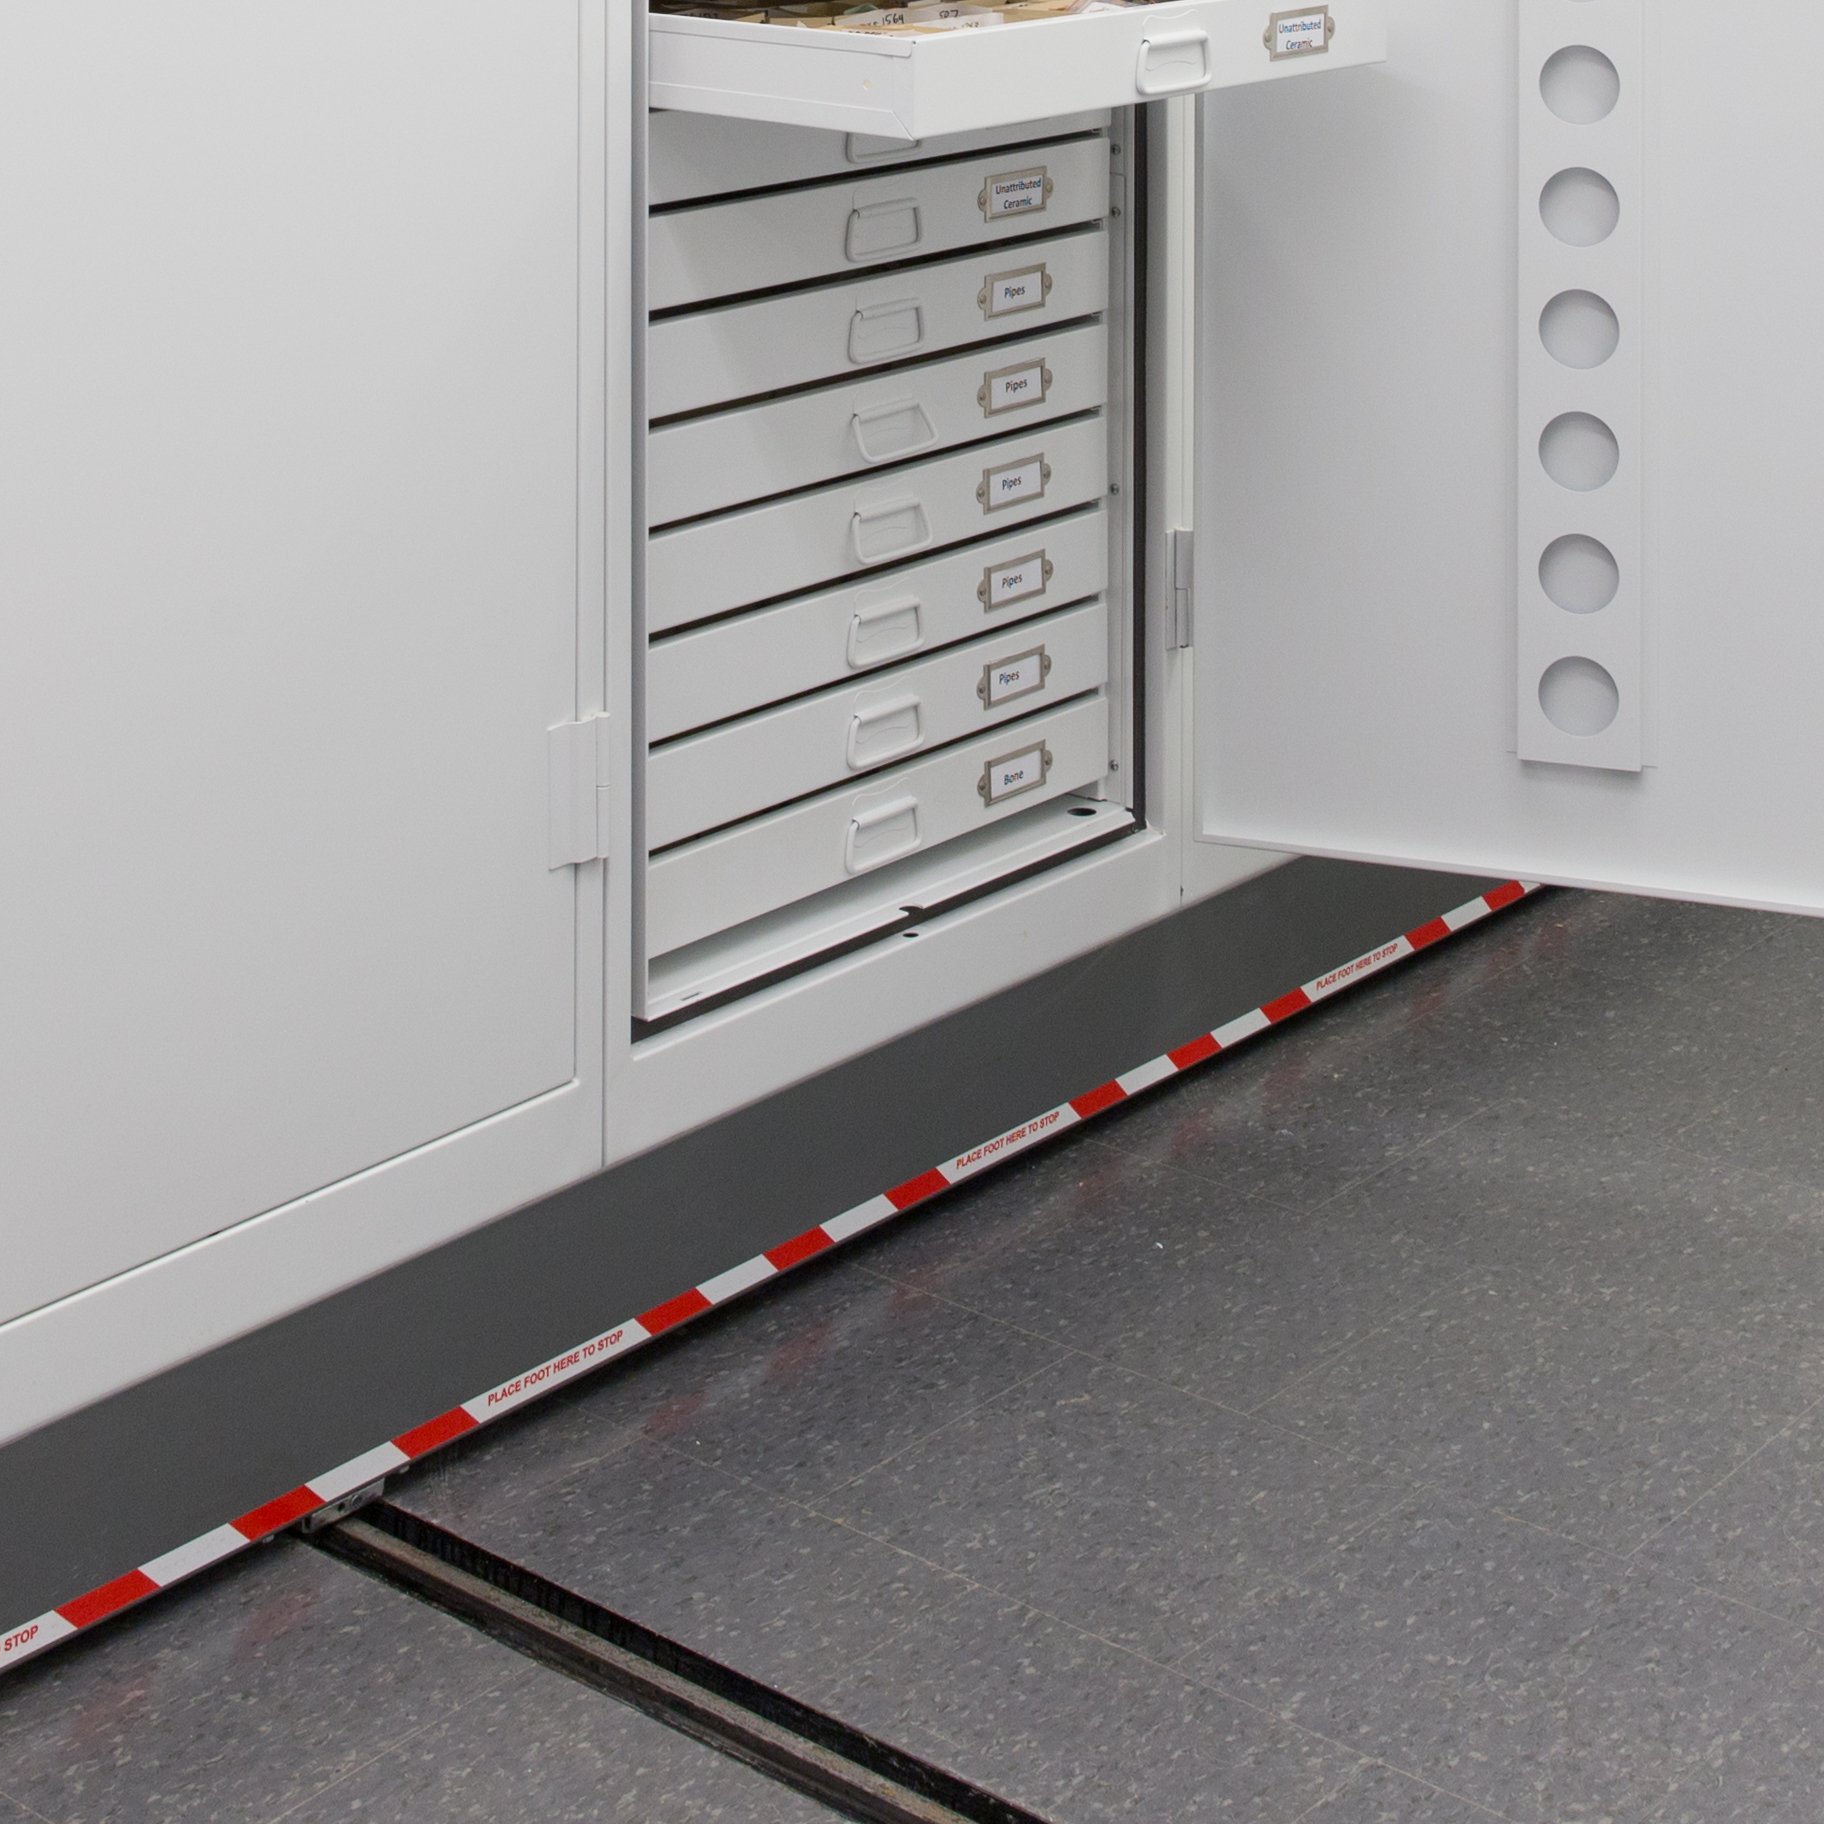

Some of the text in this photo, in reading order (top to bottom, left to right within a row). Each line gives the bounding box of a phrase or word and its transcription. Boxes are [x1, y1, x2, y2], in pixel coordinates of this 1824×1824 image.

[1279, 18, 1322, 34] Unattributed
[1286, 38, 1313, 50] Ceramic
[995, 177, 1042, 195] Unattributed
[1003, 196, 1032, 209] Ceramic
[1004, 285, 1026, 299] Pipes
[1005, 378, 1028, 393] Pipes
[1002, 476, 1022, 491] Pipes
[1002, 573, 1023, 589] Pipes
[999, 670, 1020, 685] Pipes
[1004, 770, 1024, 785] Bone
[1315, 943, 1398, 991] PLACE FOOT HERE TO STOP
[955, 1111, 1060, 1169] PLACE FOOT HERE TO STOP
[487, 1329, 624, 1407] PLACE FOOT HERE TO STOP
[4, 1624, 39, 1653] STOP
